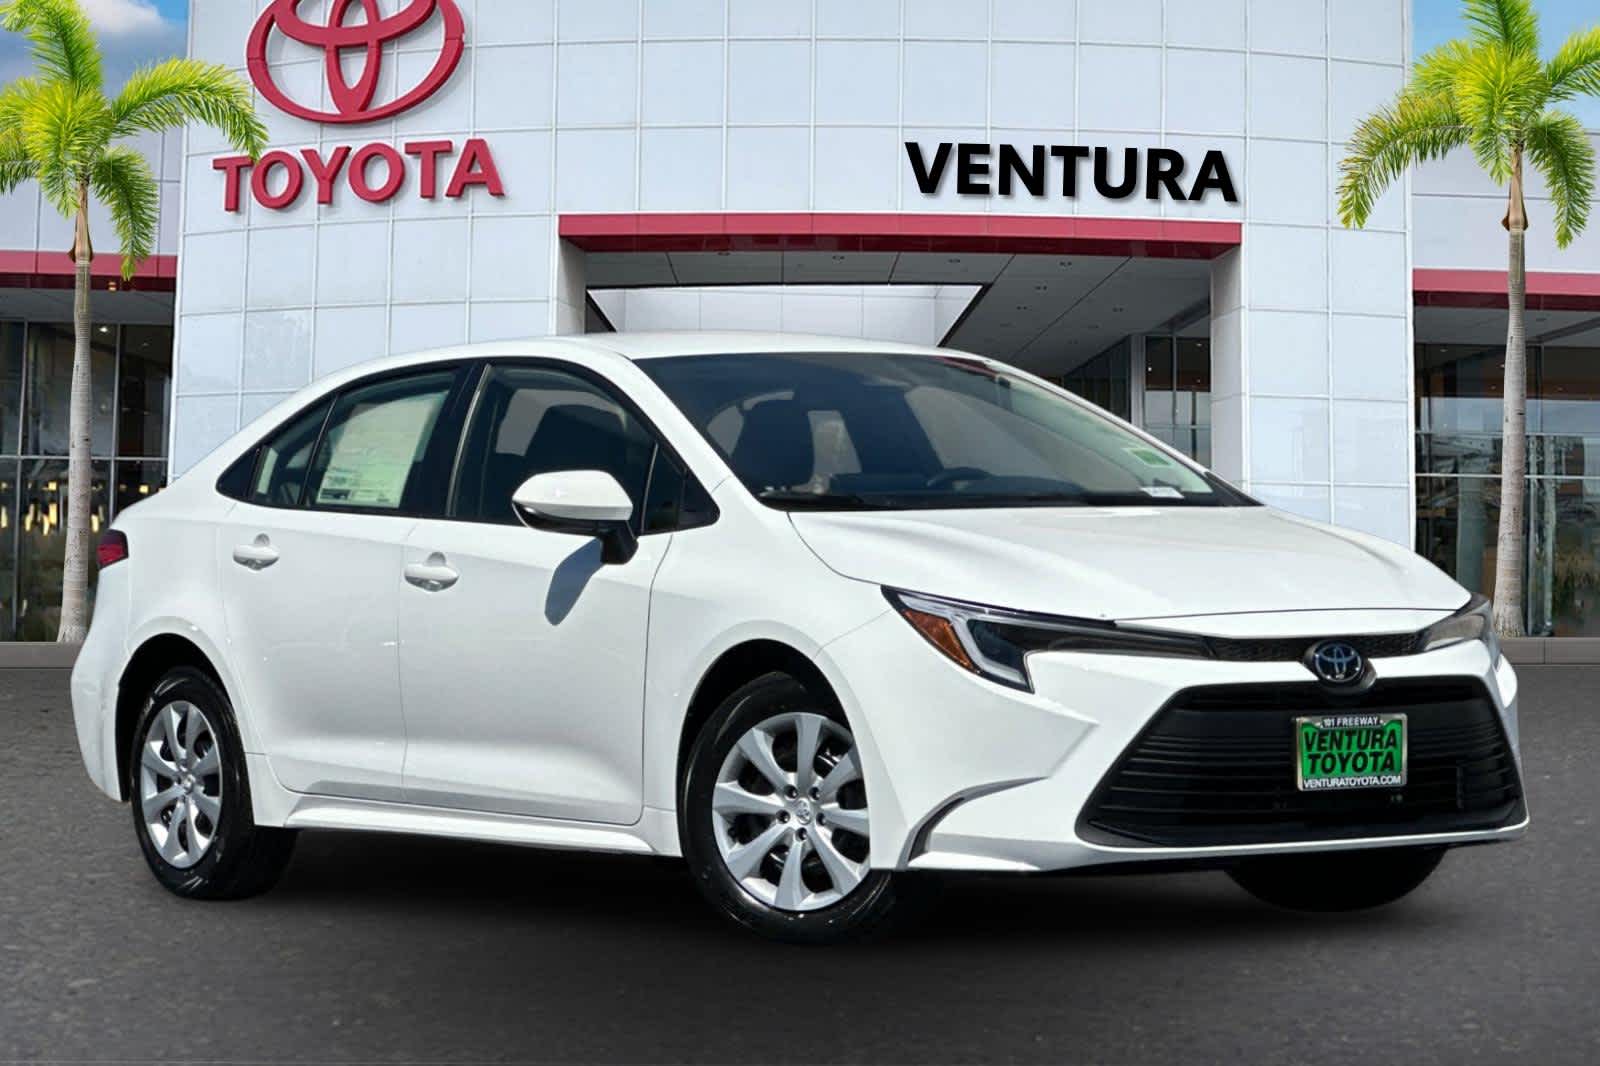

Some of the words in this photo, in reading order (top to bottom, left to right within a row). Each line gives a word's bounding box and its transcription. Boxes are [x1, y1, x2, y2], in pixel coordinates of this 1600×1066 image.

[212, 138, 505, 212] TOYOTA
[905, 141, 1238, 203] VENTURA
[1323, 717, 1335, 727] 101
[1336, 716, 1378, 727] FREEWAY
[1304, 729, 1397, 751] VENTURA
[1308, 751, 1395, 774] TOYOTA
[1303, 775, 1402, 789] VENTURATOYOTA.COM
